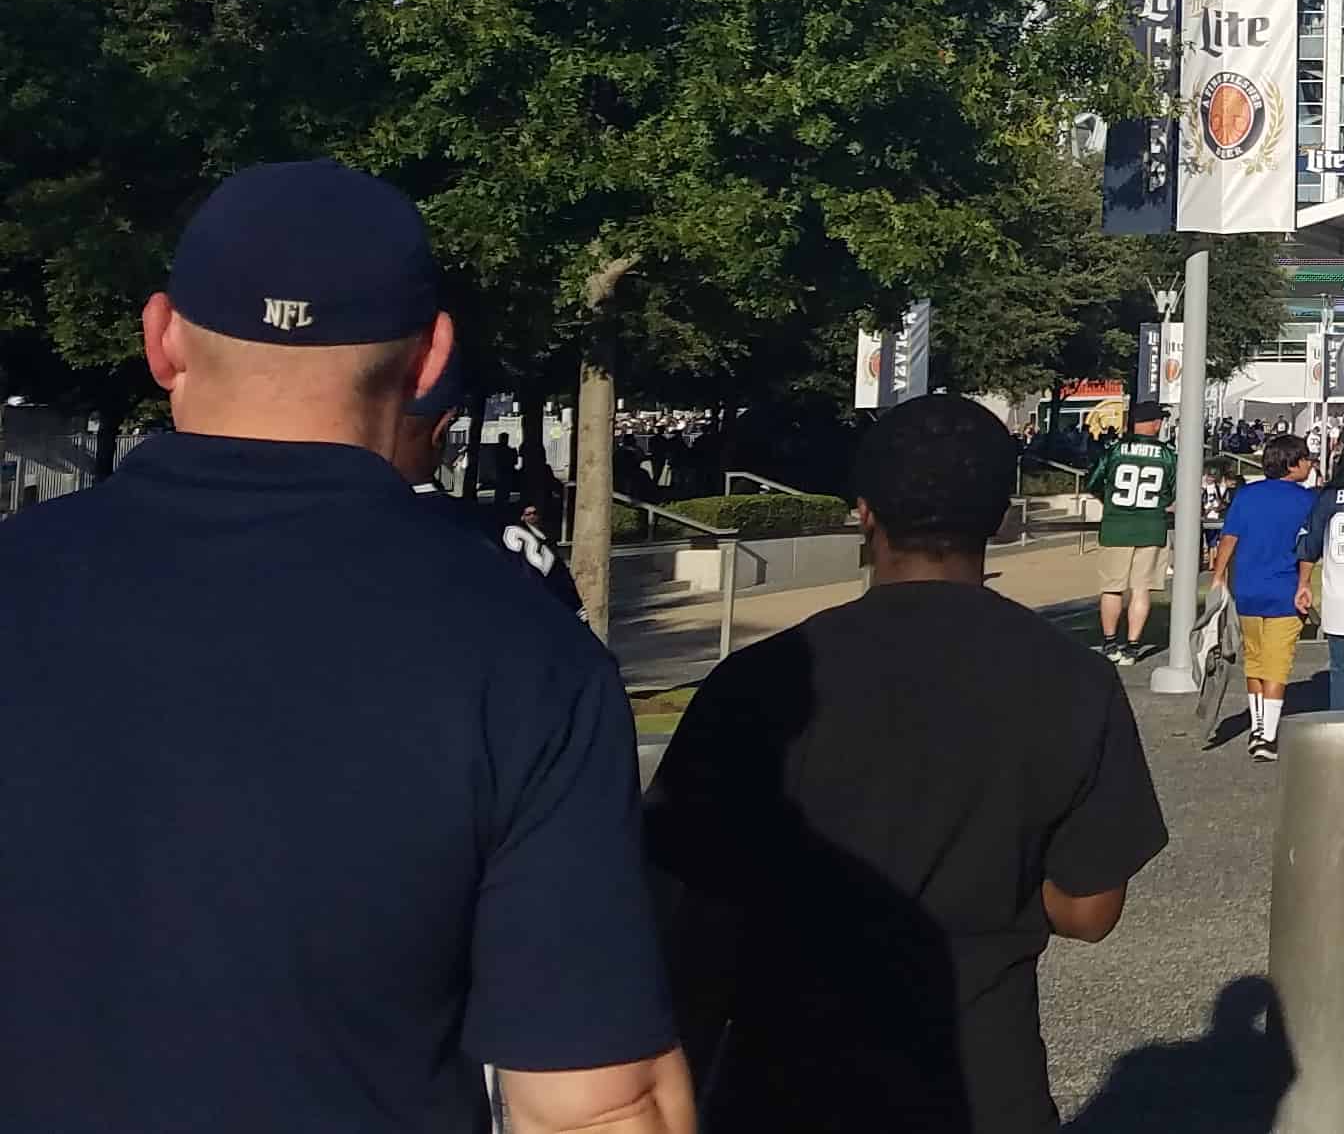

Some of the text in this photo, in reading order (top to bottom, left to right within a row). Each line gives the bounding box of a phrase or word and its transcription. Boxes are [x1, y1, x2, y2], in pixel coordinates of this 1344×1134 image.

[1200, 6, 1269, 58] Lite
[263, 297, 313, 330] NFL
[1112, 464, 1164, 507] 92
